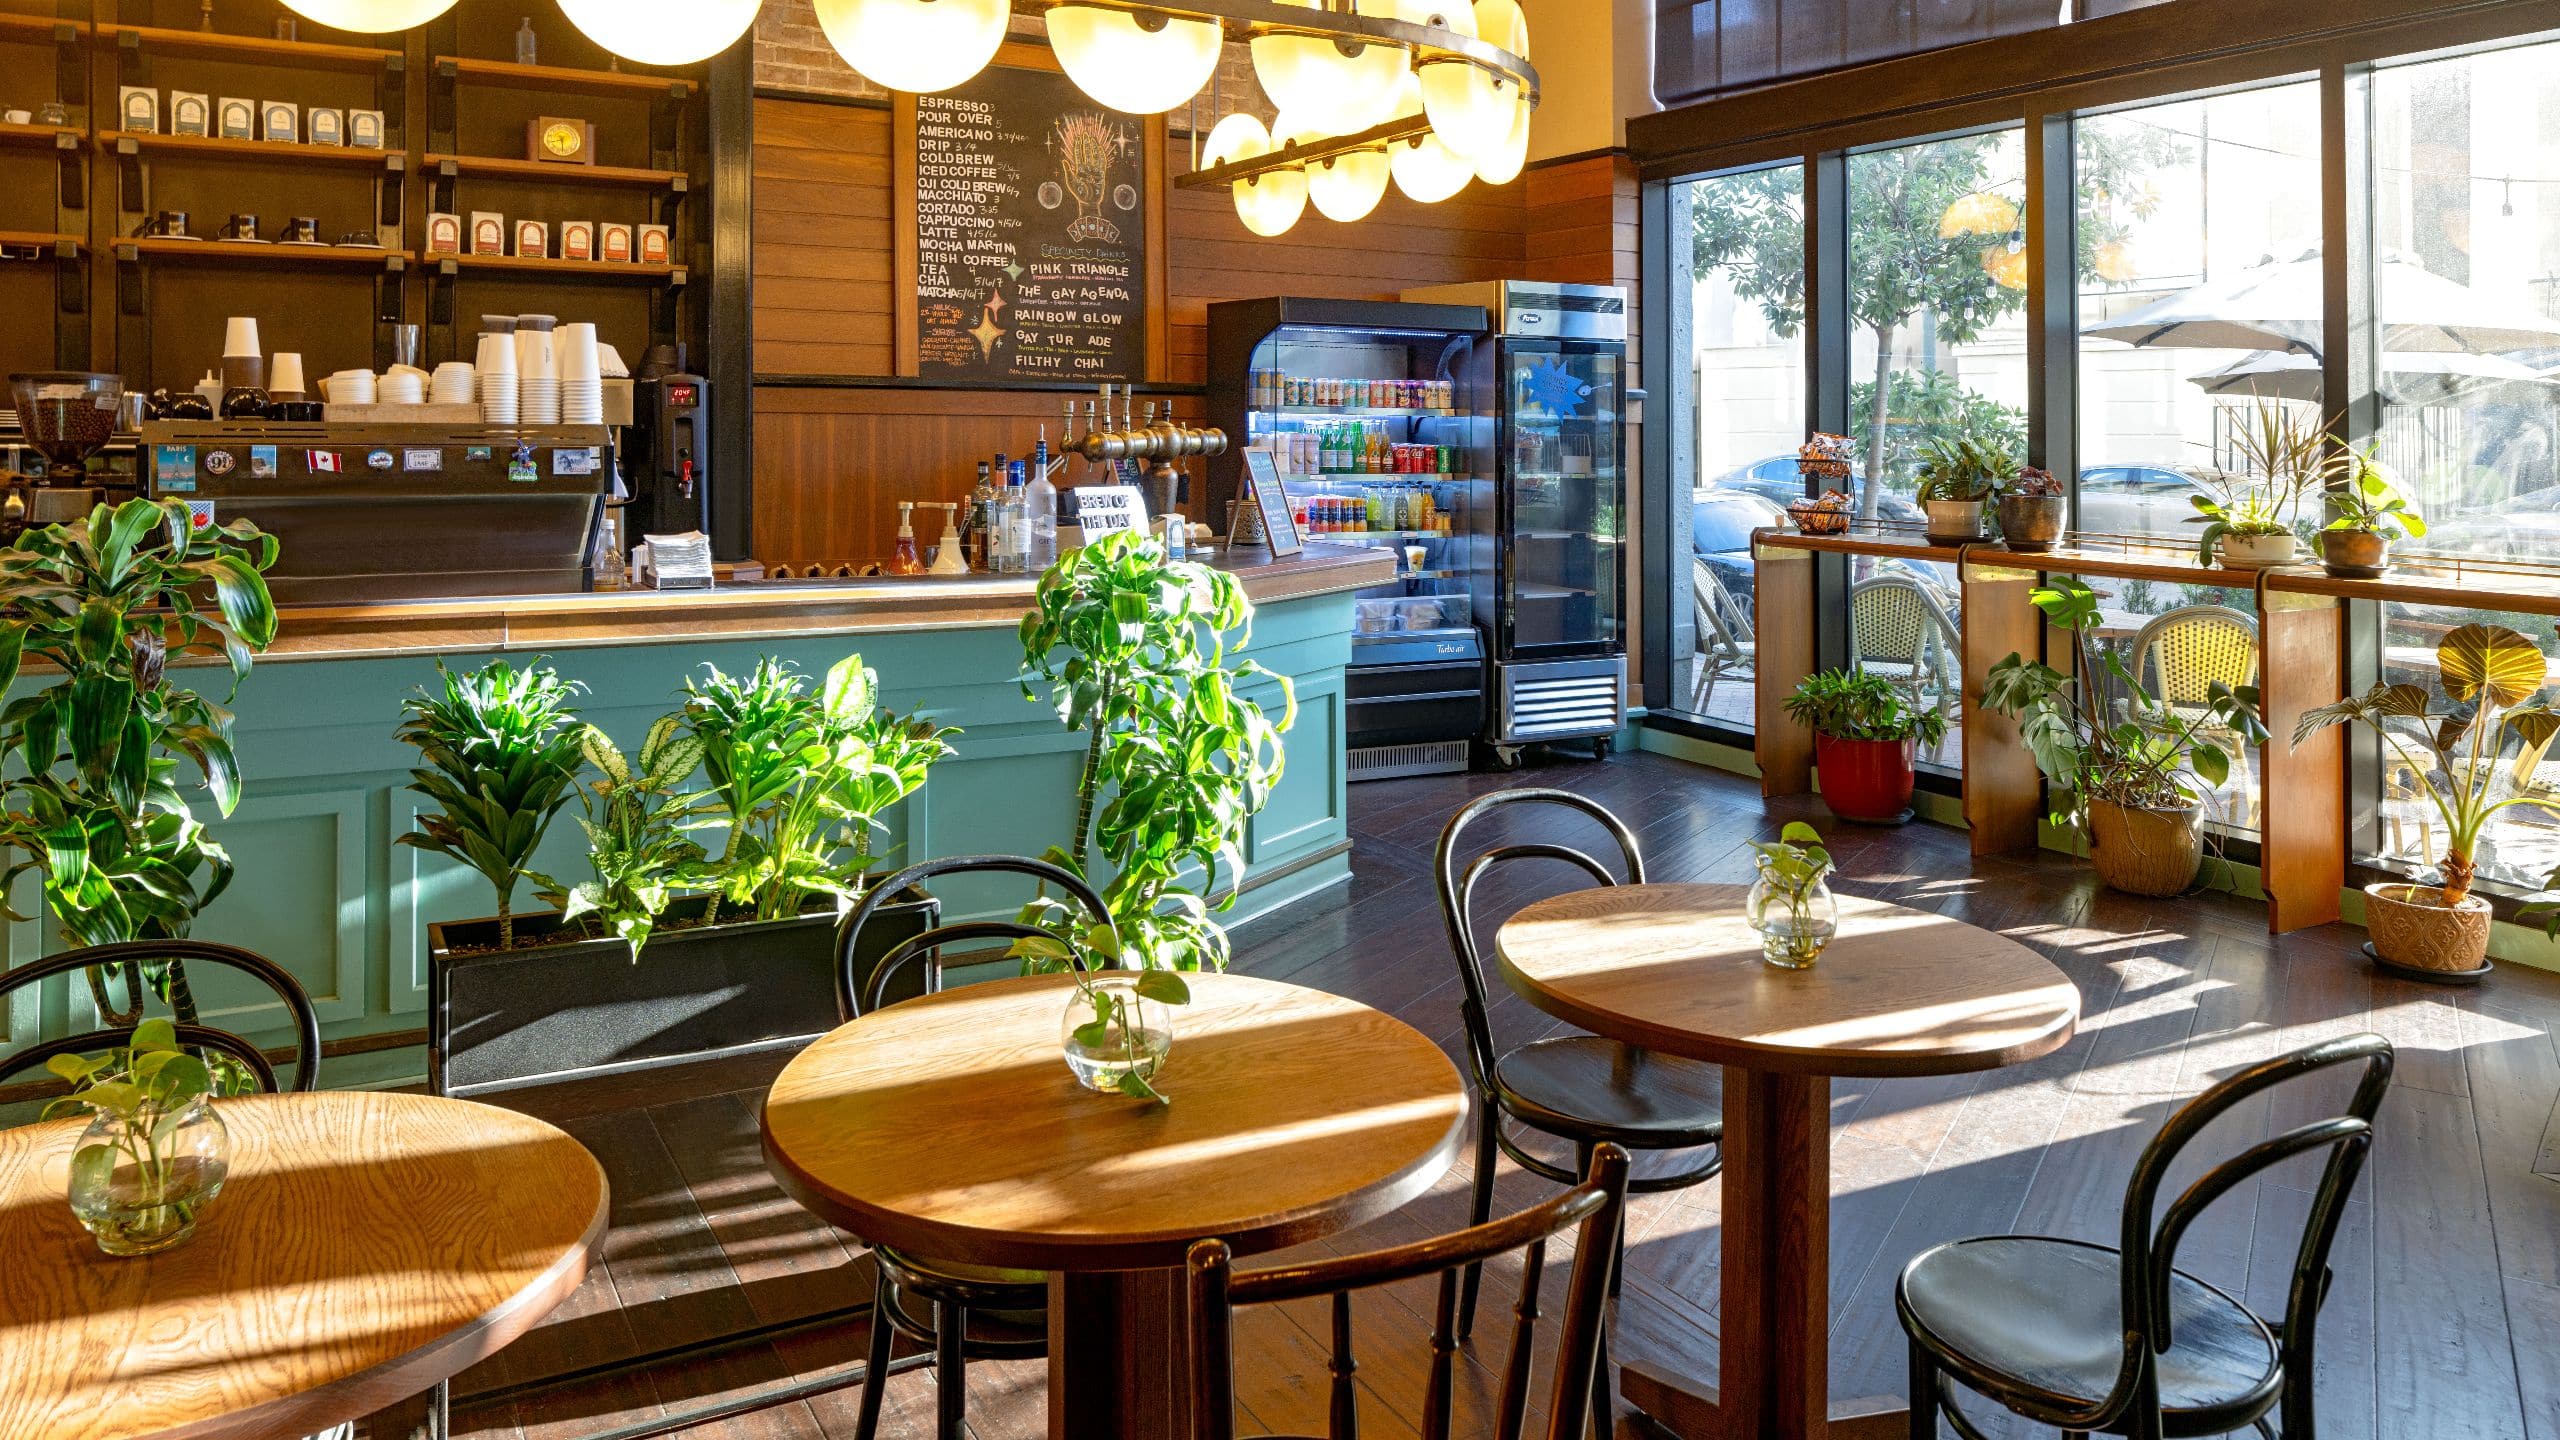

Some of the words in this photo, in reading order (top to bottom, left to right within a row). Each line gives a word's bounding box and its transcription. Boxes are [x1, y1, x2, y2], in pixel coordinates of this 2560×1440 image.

[919, 96, 989, 113] ESPRESSO
[917, 110, 951, 123] POUR
[957, 112, 993, 126] OVER
[918, 125, 993, 141] AMERICANO
[919, 139, 951, 151] DRIP
[919, 152, 954, 164] COLD
[955, 153, 994, 165] BREW
[919, 164, 948, 176] ICED
[948, 166, 997, 178] COFFEE
[917, 177, 937, 190] OJI
[940, 179, 971, 191] COLD
[972, 181, 1006, 194] BREW
[917, 189, 987, 204] MACCHIATO
[917, 202, 975, 215] CORTADO
[917, 214, 995, 229] CAPPUCCINO
[919, 225, 958, 239] LATTE
[919, 239, 963, 252] MOCHA
[966, 239, 1017, 256] MARTINI
[921, 251, 958, 264] IRISH
[962, 255, 1009, 267] COFFEE
[920, 263, 948, 275] TEA
[1030, 263, 1062, 275] PINK
[1070, 262, 1129, 277] TRIANGLE
[918, 274, 950, 286] CHAI
[917, 285, 959, 298] MATCHA
[1017, 284, 1041, 298] THE
[1051, 287, 1076, 300] GAY
[1080, 286, 1130, 301] AGENDA
[1014, 309, 1077, 323] RAINBOW
[1083, 312, 1122, 325] GLOW
[1015, 329, 1039, 344] GAY
[1046, 333, 1074, 346] TUR
[1087, 335, 1112, 347] ADE
[1015, 355, 1062, 368] FILTHY
[1073, 357, 1104, 369] CHAI
[1078, 494, 1112, 509] BREW
[1112, 494, 1130, 509] OF
[1105, 513, 1131, 528] DAY
